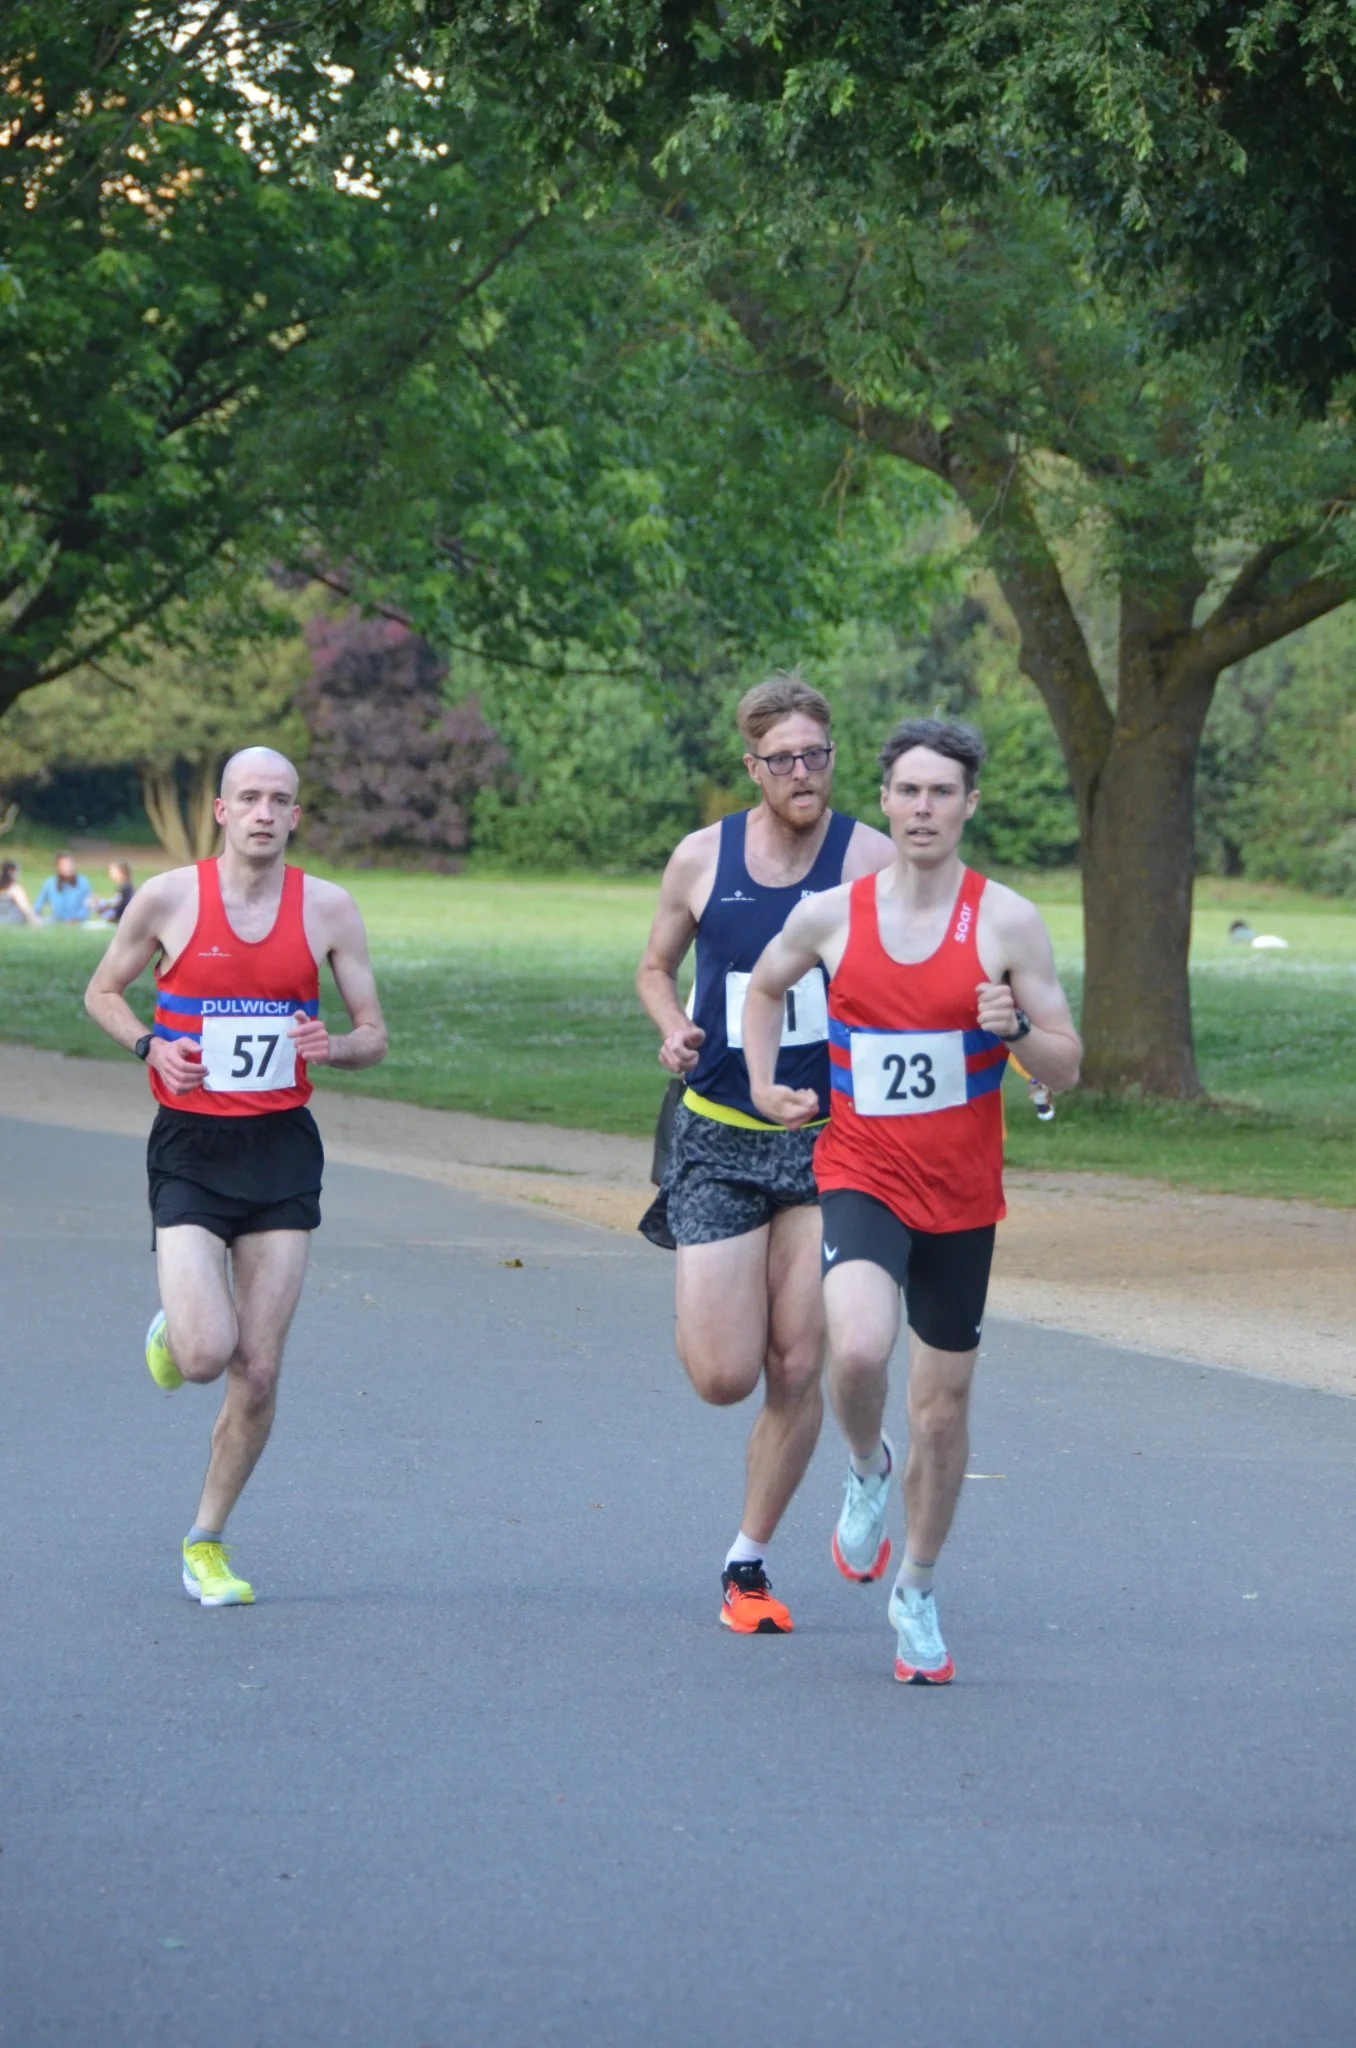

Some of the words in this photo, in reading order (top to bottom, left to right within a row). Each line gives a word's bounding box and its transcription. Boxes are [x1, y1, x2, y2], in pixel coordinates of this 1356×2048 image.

[202, 1000, 290, 1014] DULWICH
[231, 1034, 280, 1078] 57
[882, 1053, 936, 1101] 23
